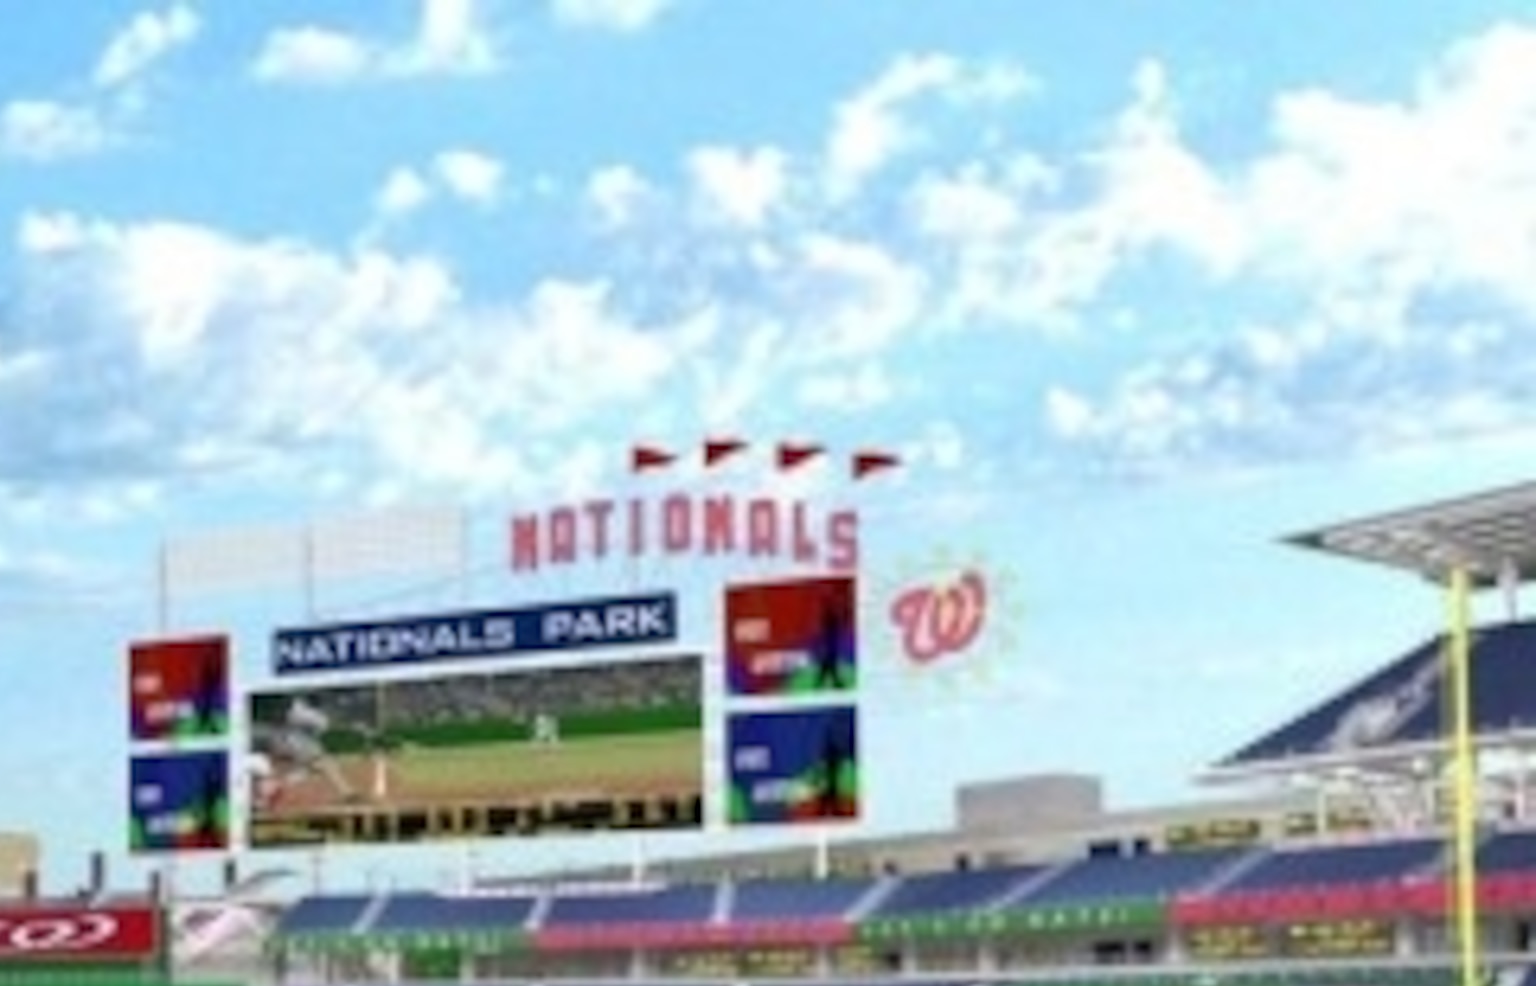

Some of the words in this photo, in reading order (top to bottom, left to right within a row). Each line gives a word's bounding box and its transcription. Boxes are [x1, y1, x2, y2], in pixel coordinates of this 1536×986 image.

[511, 496, 858, 573] NATIONALS
[279, 617, 515, 667] NATIONALS
[541, 602, 666, 644] PARK
[890, 570, 985, 663] W
